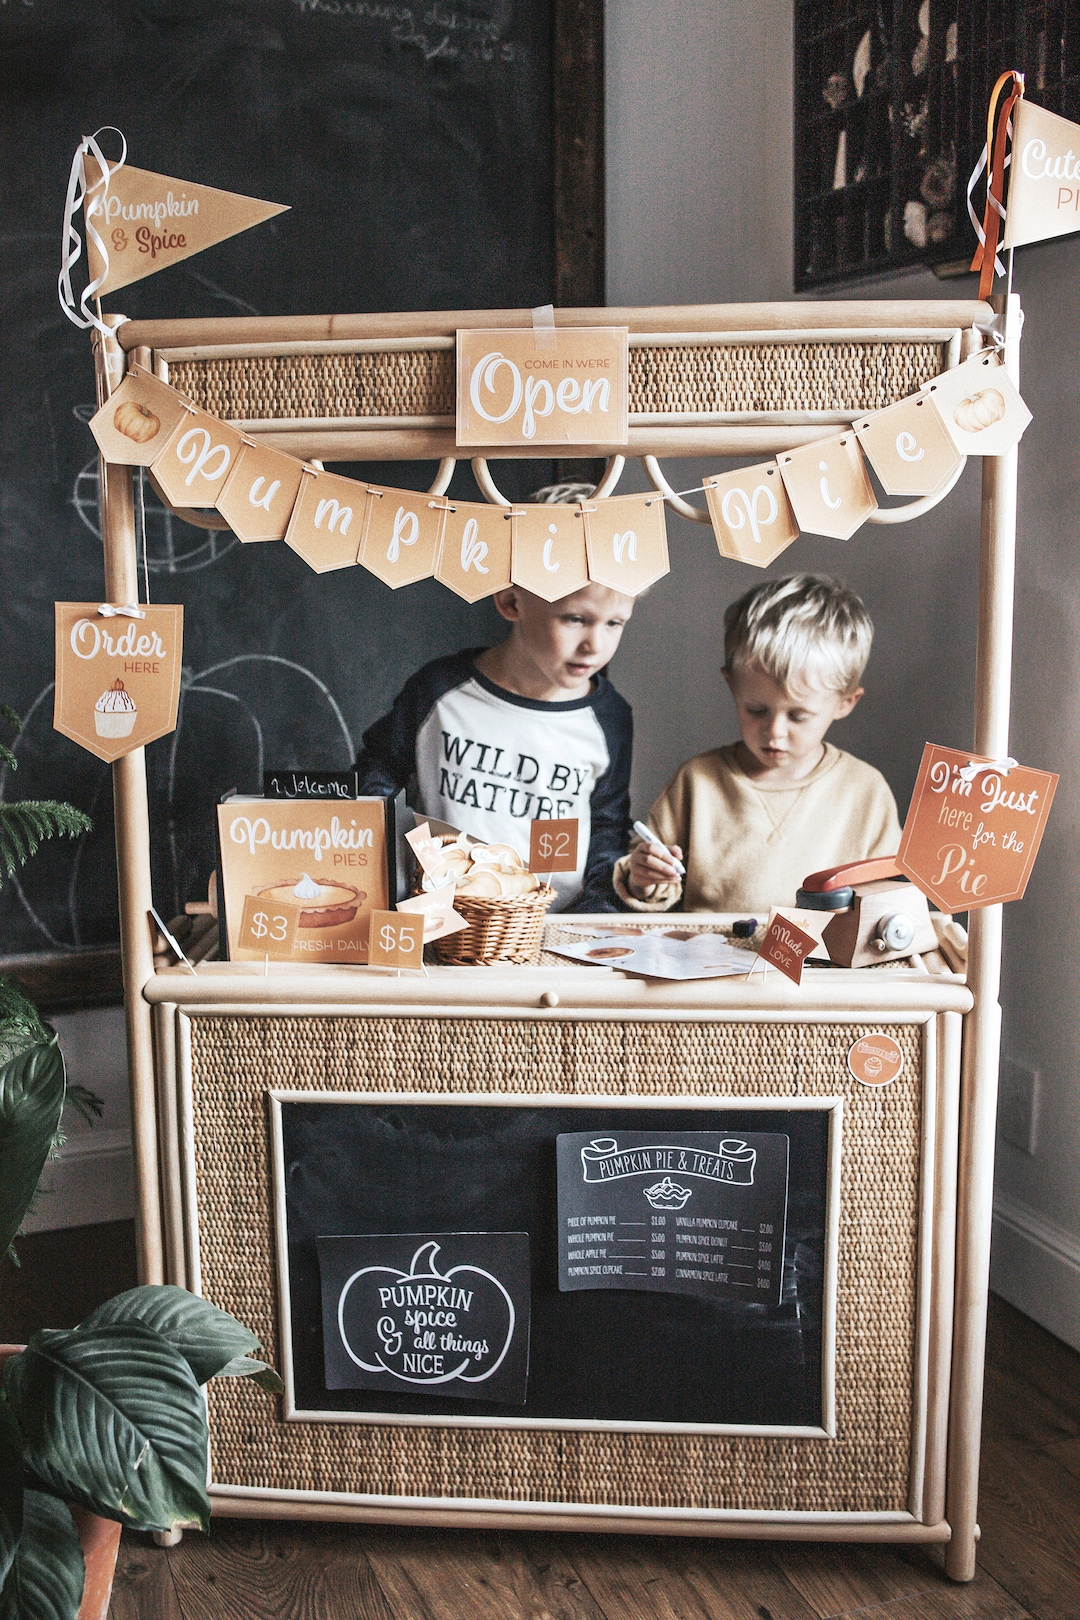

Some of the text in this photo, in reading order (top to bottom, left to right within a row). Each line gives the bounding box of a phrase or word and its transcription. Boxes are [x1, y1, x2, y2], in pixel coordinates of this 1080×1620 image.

[92, 191, 199, 228] Pumpkin
[111, 226, 187, 258] & Spice
[524, 358, 610, 370] COME IN WE'RE
[470, 352, 611, 439] Open
[70, 618, 166, 660] Order
[124, 662, 160, 673] HERE
[442, 731, 589, 796] WILD BY
[439, 768, 574, 820] NATURE
[930, 761, 1039, 814] I'm Just
[938, 796, 973, 831] here
[230, 816, 374, 861] Pumpkin
[538, 832, 570, 860] $2
[972, 822, 1024, 853] for the
[333, 854, 368, 866] PIES
[931, 843, 988, 896] Pie
[251, 911, 288, 940] $3
[379, 925, 415, 953] $5
[771, 924, 803, 957] Made
[769, 946, 793, 969] LOVE
[599, 1150, 734, 1179] PUMPKIN PIE & TREATS
[567, 1215, 666, 1227] PIECE OF PUMPKIN PIE $1.00
[675, 1216, 695, 1228] VANILLA
[695, 1217, 718, 1229] PUMPKIN
[718, 1219, 738, 1231] CUPCAKE
[567, 1232, 666, 1244] WHOLE PUMPKIN PIE $5.00
[675, 1233, 698, 1245] PUMPKIN
[698, 1235, 710, 1247] SPICE
[567, 1248, 666, 1260] WHOLE APPLE PIE $5.00
[675, 1250, 698, 1262] PUMPKIN
[698, 1252, 710, 1264] SPICE
[711, 1254, 724, 1265] LATTE
[567, 1264, 666, 1277] PUMPKIN SPICE CUPCAKE $2.00
[675, 1268, 702, 1281] CINNAMON
[702, 1270, 715, 1282] SPICE
[379, 1285, 474, 1312] PUMPKIN
[404, 1305, 457, 1334] spice
[376, 1316, 490, 1361] & all things
[403, 1353, 444, 1375] NICE
